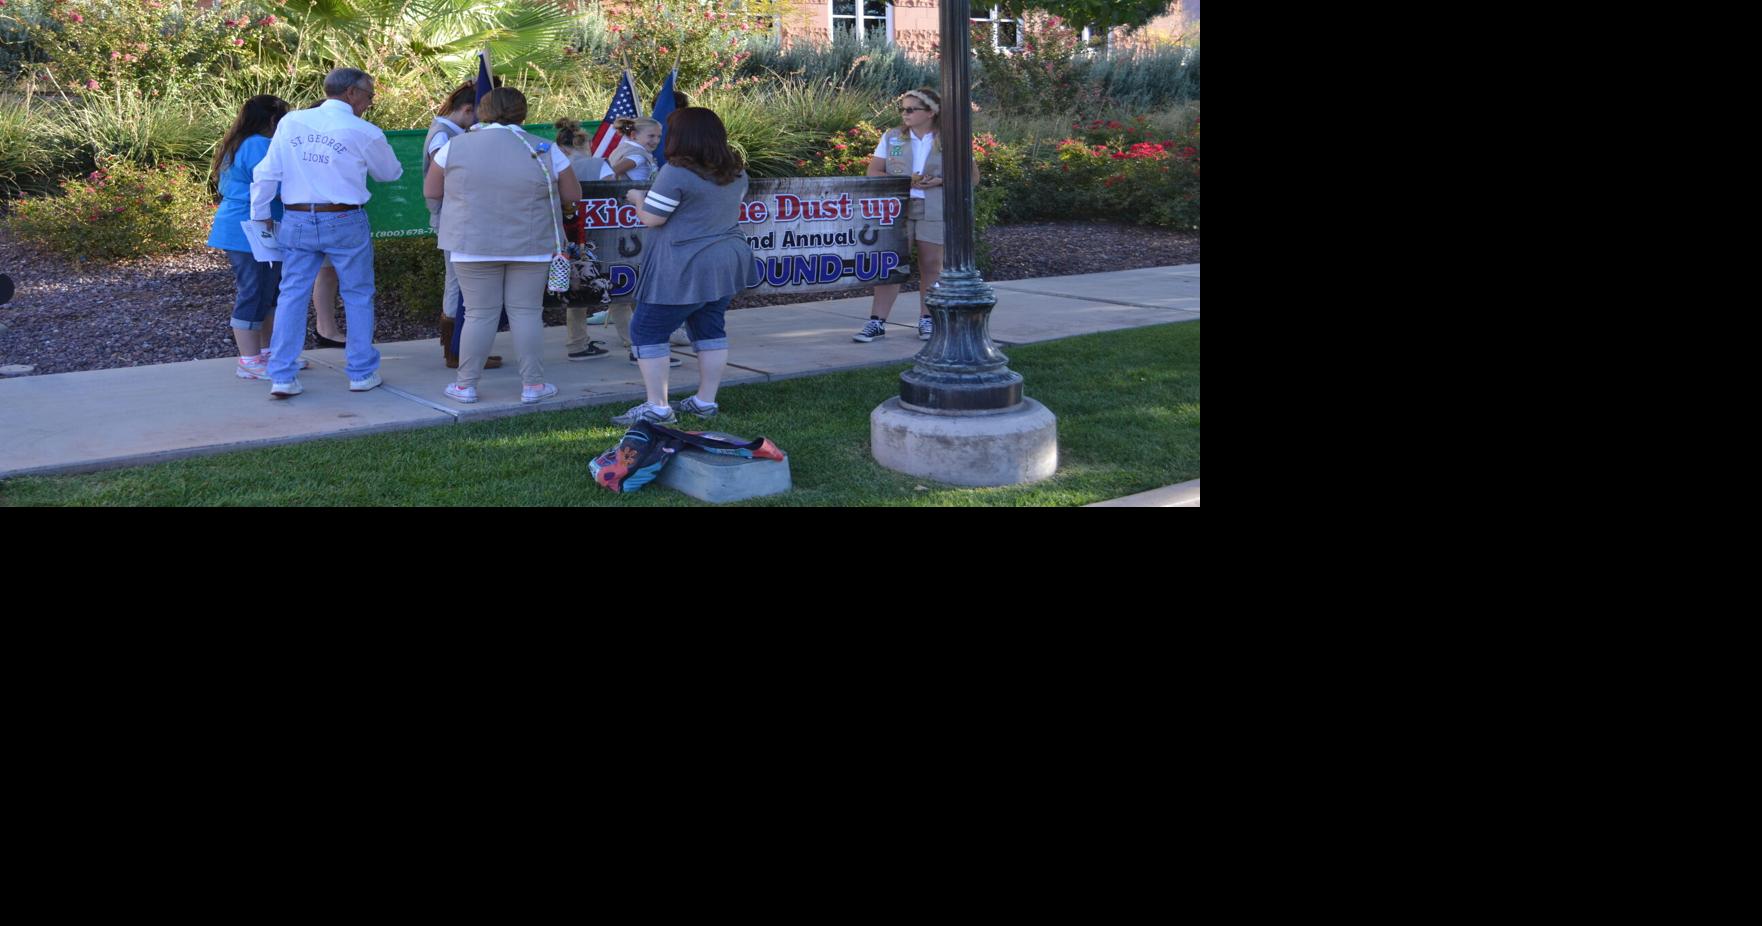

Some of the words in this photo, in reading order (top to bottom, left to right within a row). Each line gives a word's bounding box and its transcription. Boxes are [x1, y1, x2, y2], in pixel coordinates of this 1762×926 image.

[307, 134, 348, 154] GEORGE
[302, 152, 329, 164] LIONS
[577, 198, 648, 229] Kic
[774, 193, 852, 222] Dust
[859, 197, 901, 225] up
[746, 231, 775, 250] nd
[781, 228, 856, 249] Annual
